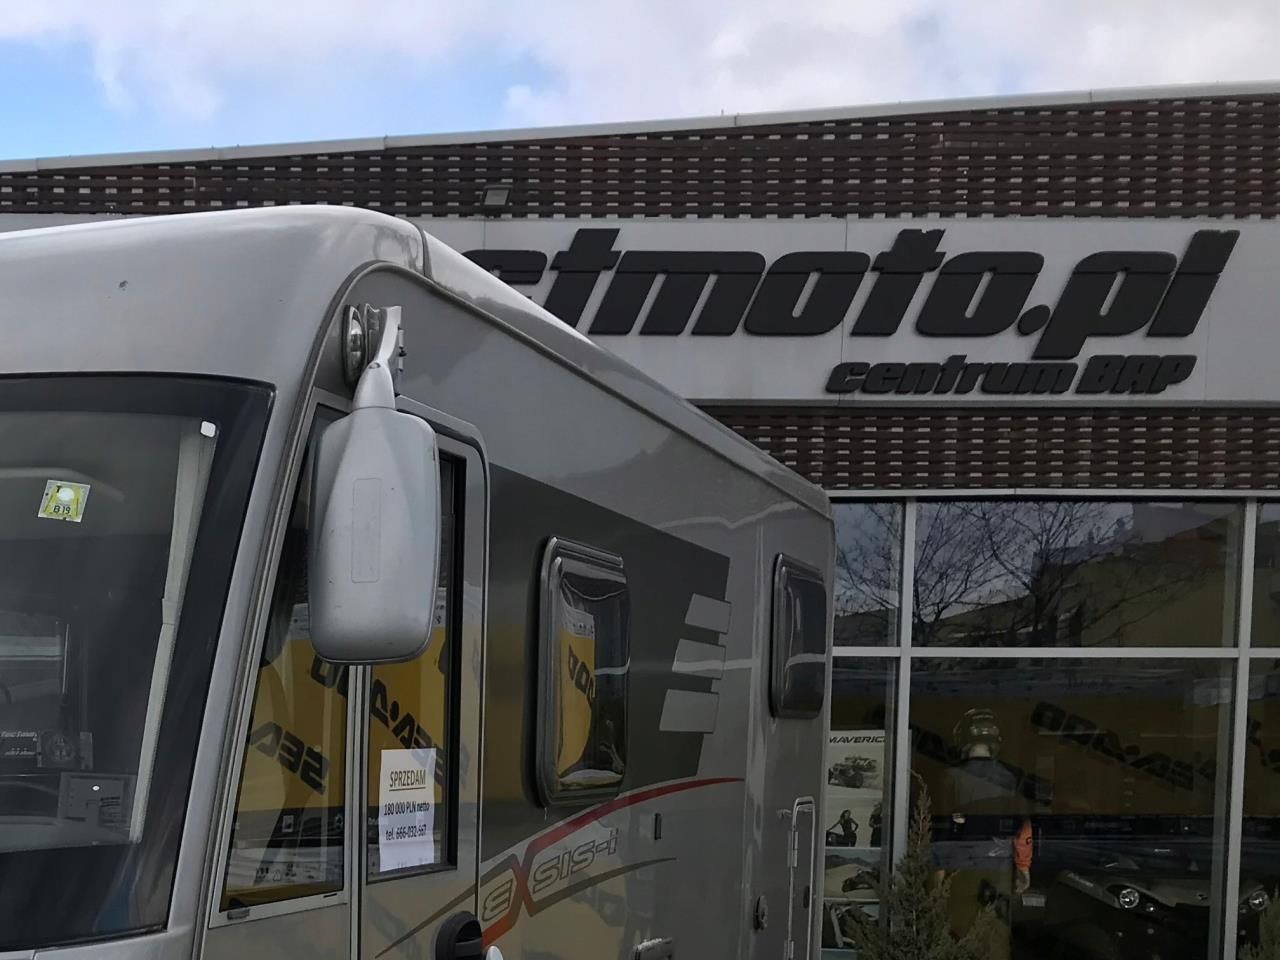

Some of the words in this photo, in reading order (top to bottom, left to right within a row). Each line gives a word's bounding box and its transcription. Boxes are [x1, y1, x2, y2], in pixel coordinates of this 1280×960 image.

[462, 228, 1241, 358] tmoto.pl
[825, 354, 1079, 394] centrum
[389, 769, 426, 788] SPRZEDAM
[384, 803, 394, 816] 180
[395, 802, 405, 815] 000
[405, 801, 416, 814] PLN
[385, 828, 394, 841] tel.
